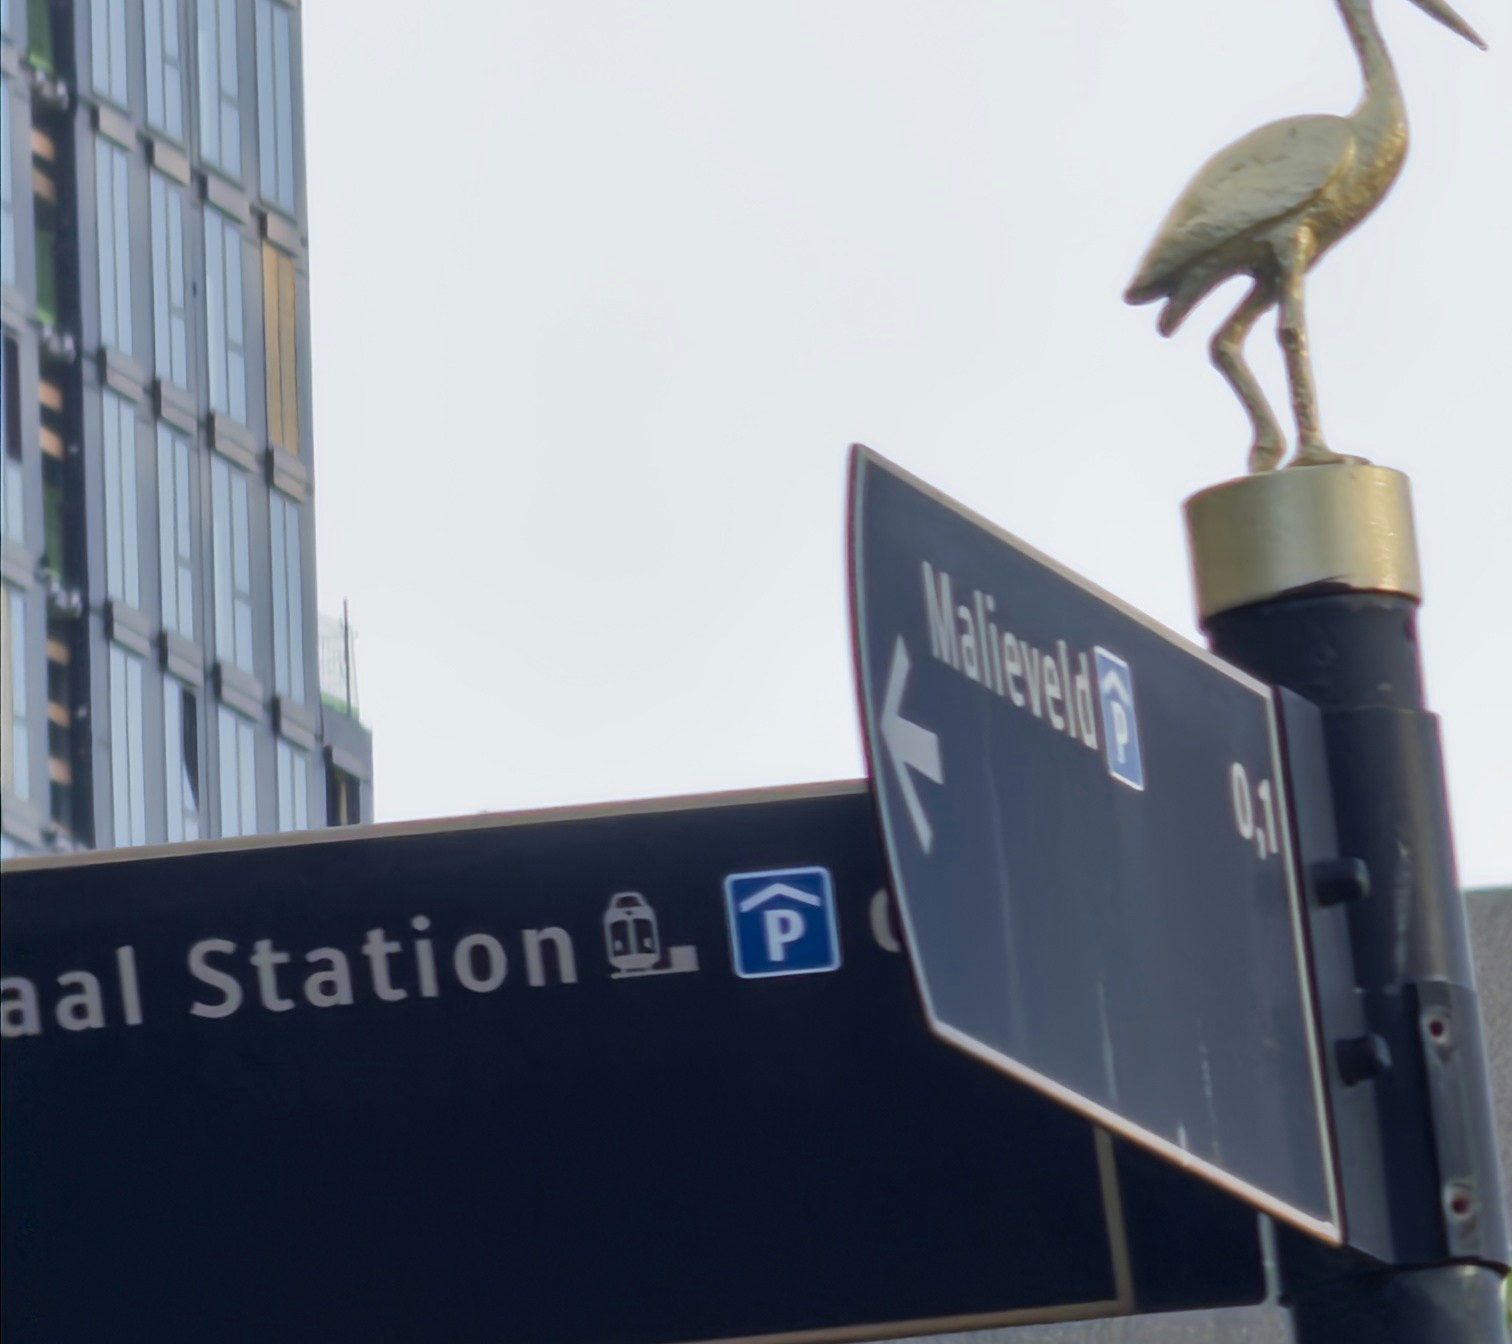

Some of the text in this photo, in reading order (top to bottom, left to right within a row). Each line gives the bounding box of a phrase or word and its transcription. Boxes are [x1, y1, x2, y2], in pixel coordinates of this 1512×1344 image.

[921, 559, 1099, 751] Malieveld
[1230, 760, 1279, 861] 0,1
[188, 913, 579, 1020] Station
